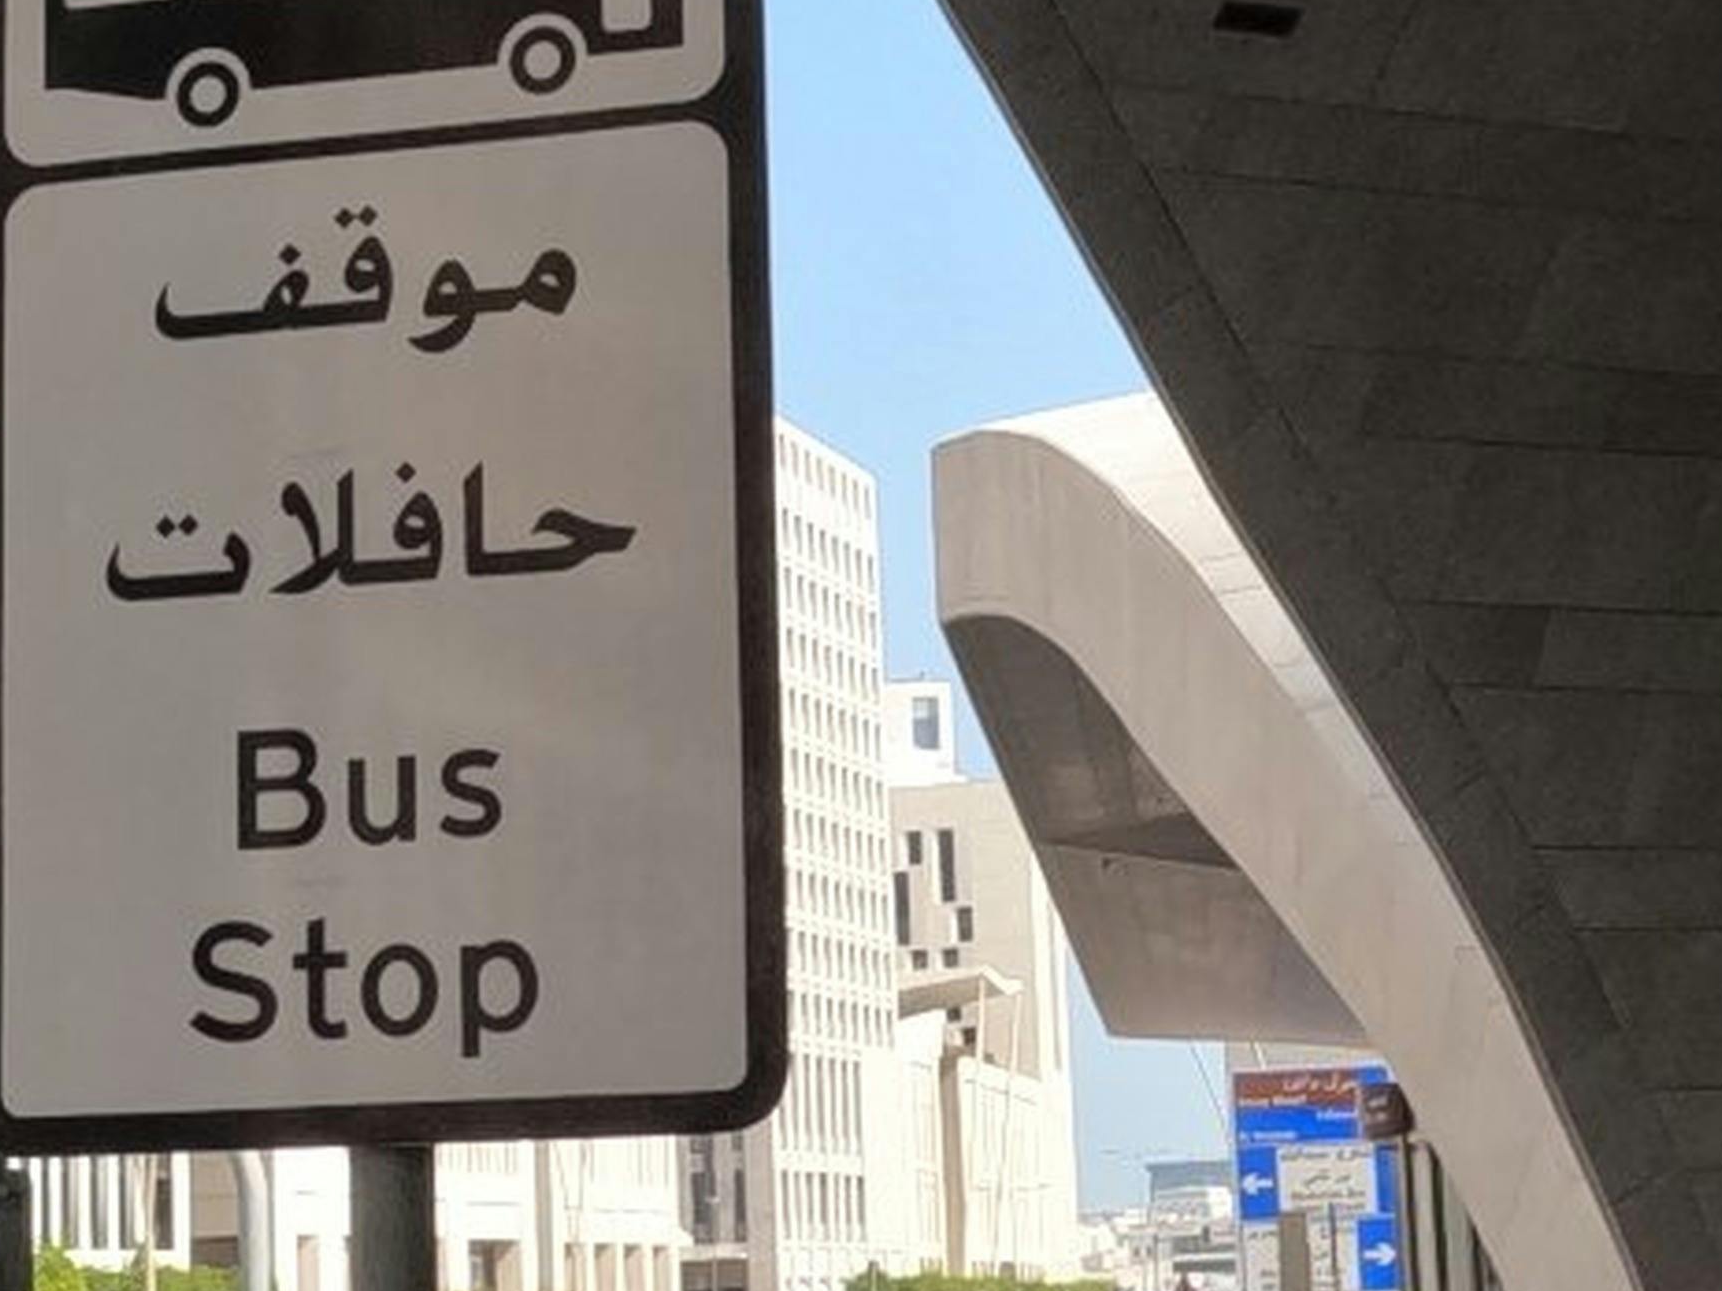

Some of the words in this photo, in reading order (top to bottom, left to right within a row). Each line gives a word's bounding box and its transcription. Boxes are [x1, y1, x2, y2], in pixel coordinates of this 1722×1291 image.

[155, 205, 577, 354] موقف
[106, 461, 637, 602] حافلات
[236, 728, 503, 851] Bus
[189, 917, 540, 1059] Stop
